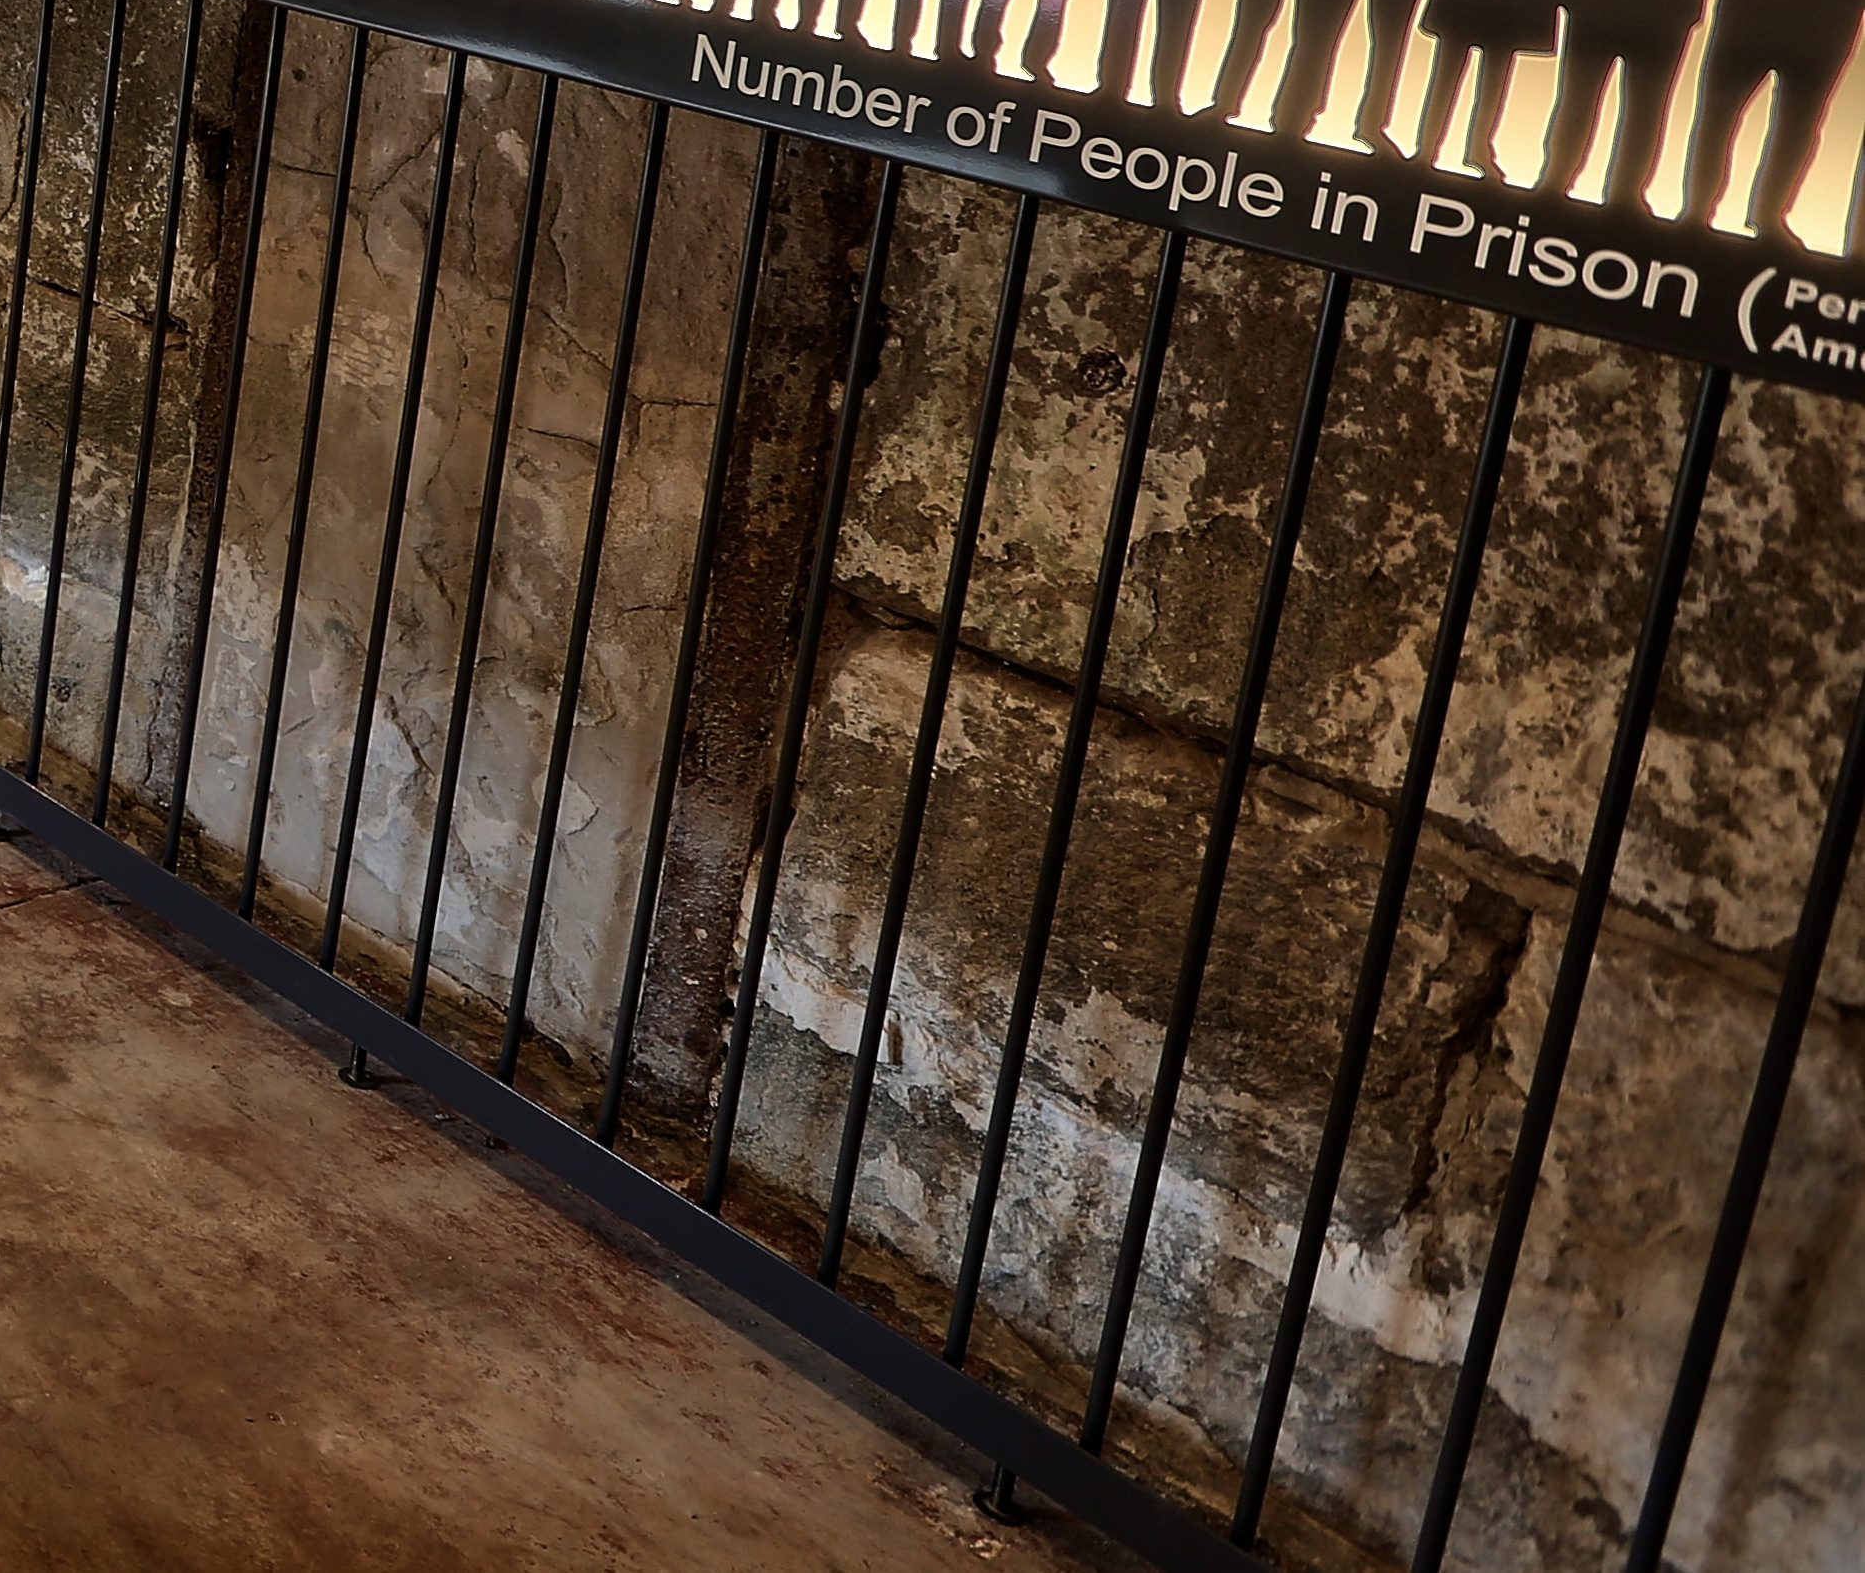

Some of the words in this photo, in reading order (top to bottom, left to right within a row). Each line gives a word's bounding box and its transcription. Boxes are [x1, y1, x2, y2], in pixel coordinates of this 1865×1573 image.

[692, 34, 931, 133] Number
[947, 101, 1016, 153] of
[1030, 110, 1283, 217] People
[1311, 172, 1378, 242] in
[1410, 193, 1698, 317] Prison
